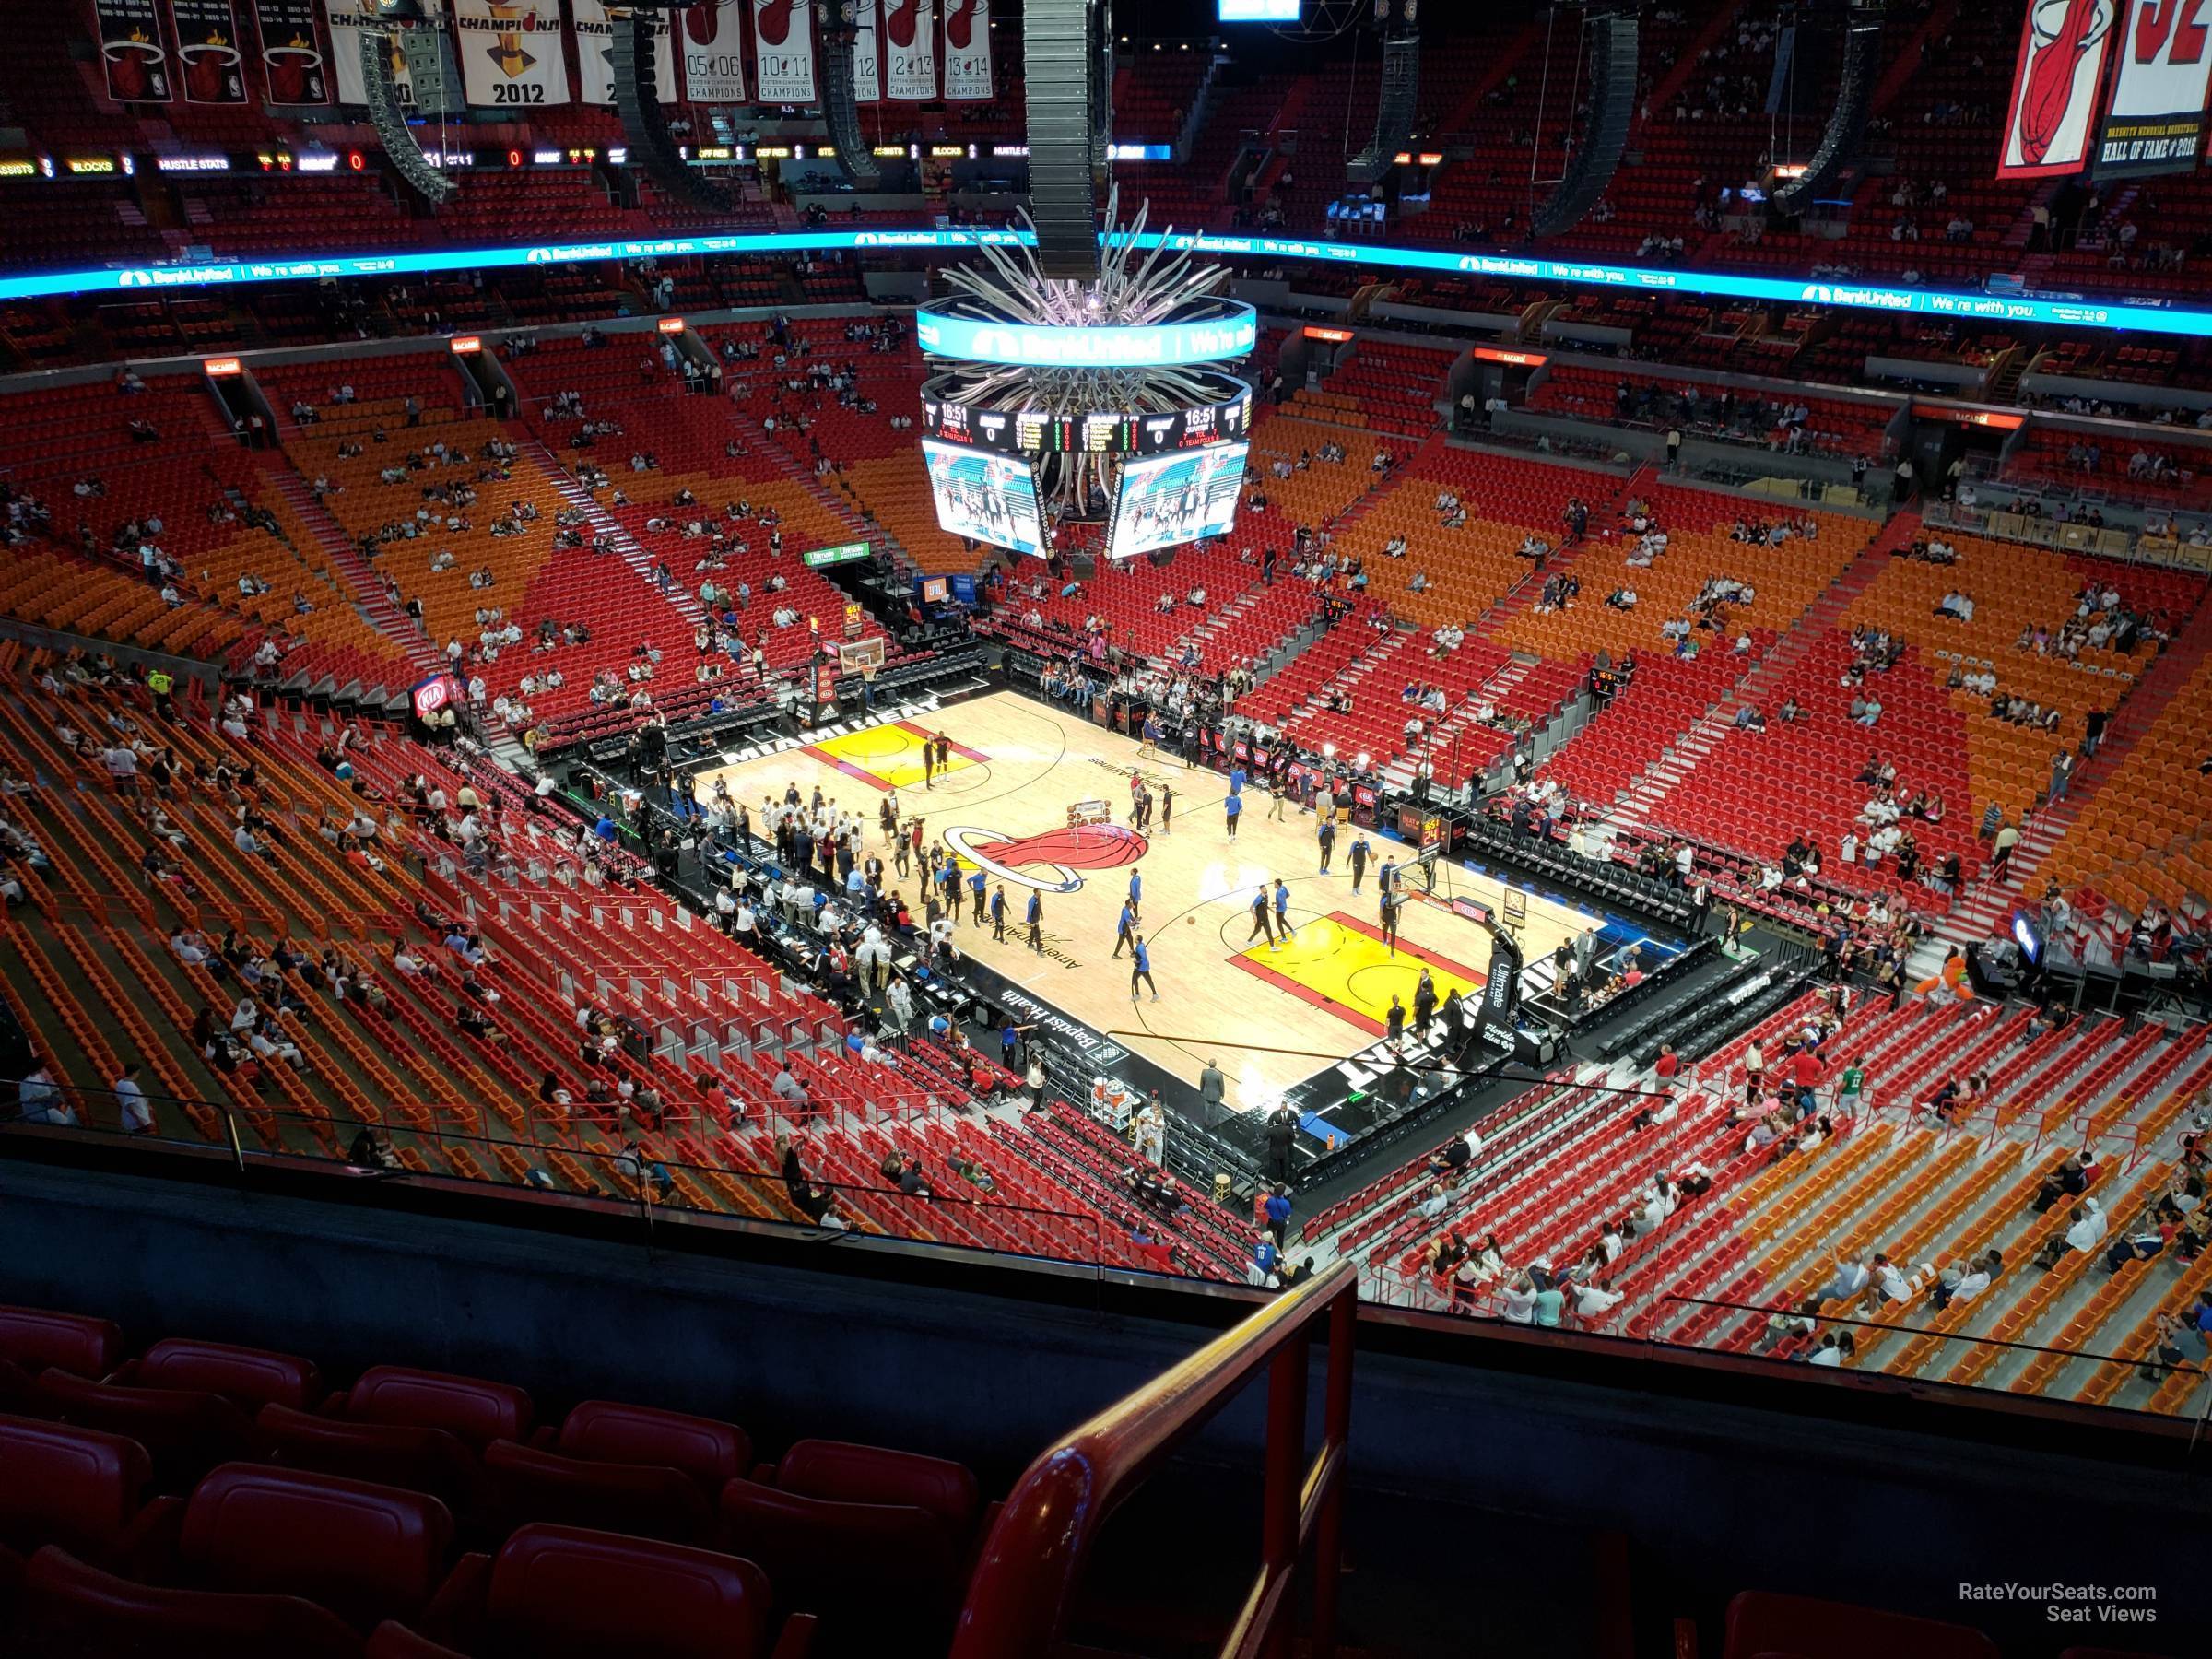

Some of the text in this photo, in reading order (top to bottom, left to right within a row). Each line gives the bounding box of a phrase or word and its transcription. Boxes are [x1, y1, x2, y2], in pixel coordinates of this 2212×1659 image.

[688, 55, 739, 76] 05 06
[761, 57, 809, 76] 10 11
[859, 58, 875, 76] 12
[949, 58, 988, 76] 13 14
[493, 84, 545, 103] 2012
[689, 88, 742, 98] CHAMPIONS
[761, 88, 811, 98] CHAMPIONS
[890, 86, 934, 96] CHAMPIONS
[947, 87, 991, 96] CHAMPIONS
[994, 147, 1020, 156] HUSTLE
[2101, 137, 2197, 162] HALL OF FAME 2016
[73, 161, 112, 172] BLOCKS
[159, 159, 228, 170] HUSTLE STATS
[351, 155, 361, 170] 0
[511, 152, 519, 165] 0
[1482, 258, 1538, 275] BankUnited
[153, 269, 233, 285] BankUnited
[1833, 288, 1911, 308] BankUnited
[1932, 297, 1971, 312] We're
[1974, 300, 2005, 315] with
[1022, 334, 1161, 359] BankUnited
[942, 403, 967, 425] 16:51
[1185, 407, 1216, 427] 16:51
[987, 429, 995, 441] 0
[1155, 430, 1163, 444] 0
[1186, 425, 1209, 433] QUARTER
[1185, 439, 1199, 447] TEAM
[1199, 437, 1215, 445] FOULS
[1034, 472, 1053, 548] MICCOSUKEE.COM
[1107, 473, 1122, 549] MICCOSUKEE.COM
[929, 583, 944, 596] JBL
[421, 687, 441, 708] KIA
[819, 712, 839, 721] adidas
[721, 695, 942, 765] MIAMI HEAT
[1424, 830, 1438, 845] 24
[1494, 963, 1510, 1008] Ultimate
[1001, 989, 1100, 1049] Baptist Health
[1483, 1031, 1500, 1045] Blue
[1485, 1023, 1515, 1042] Florida
